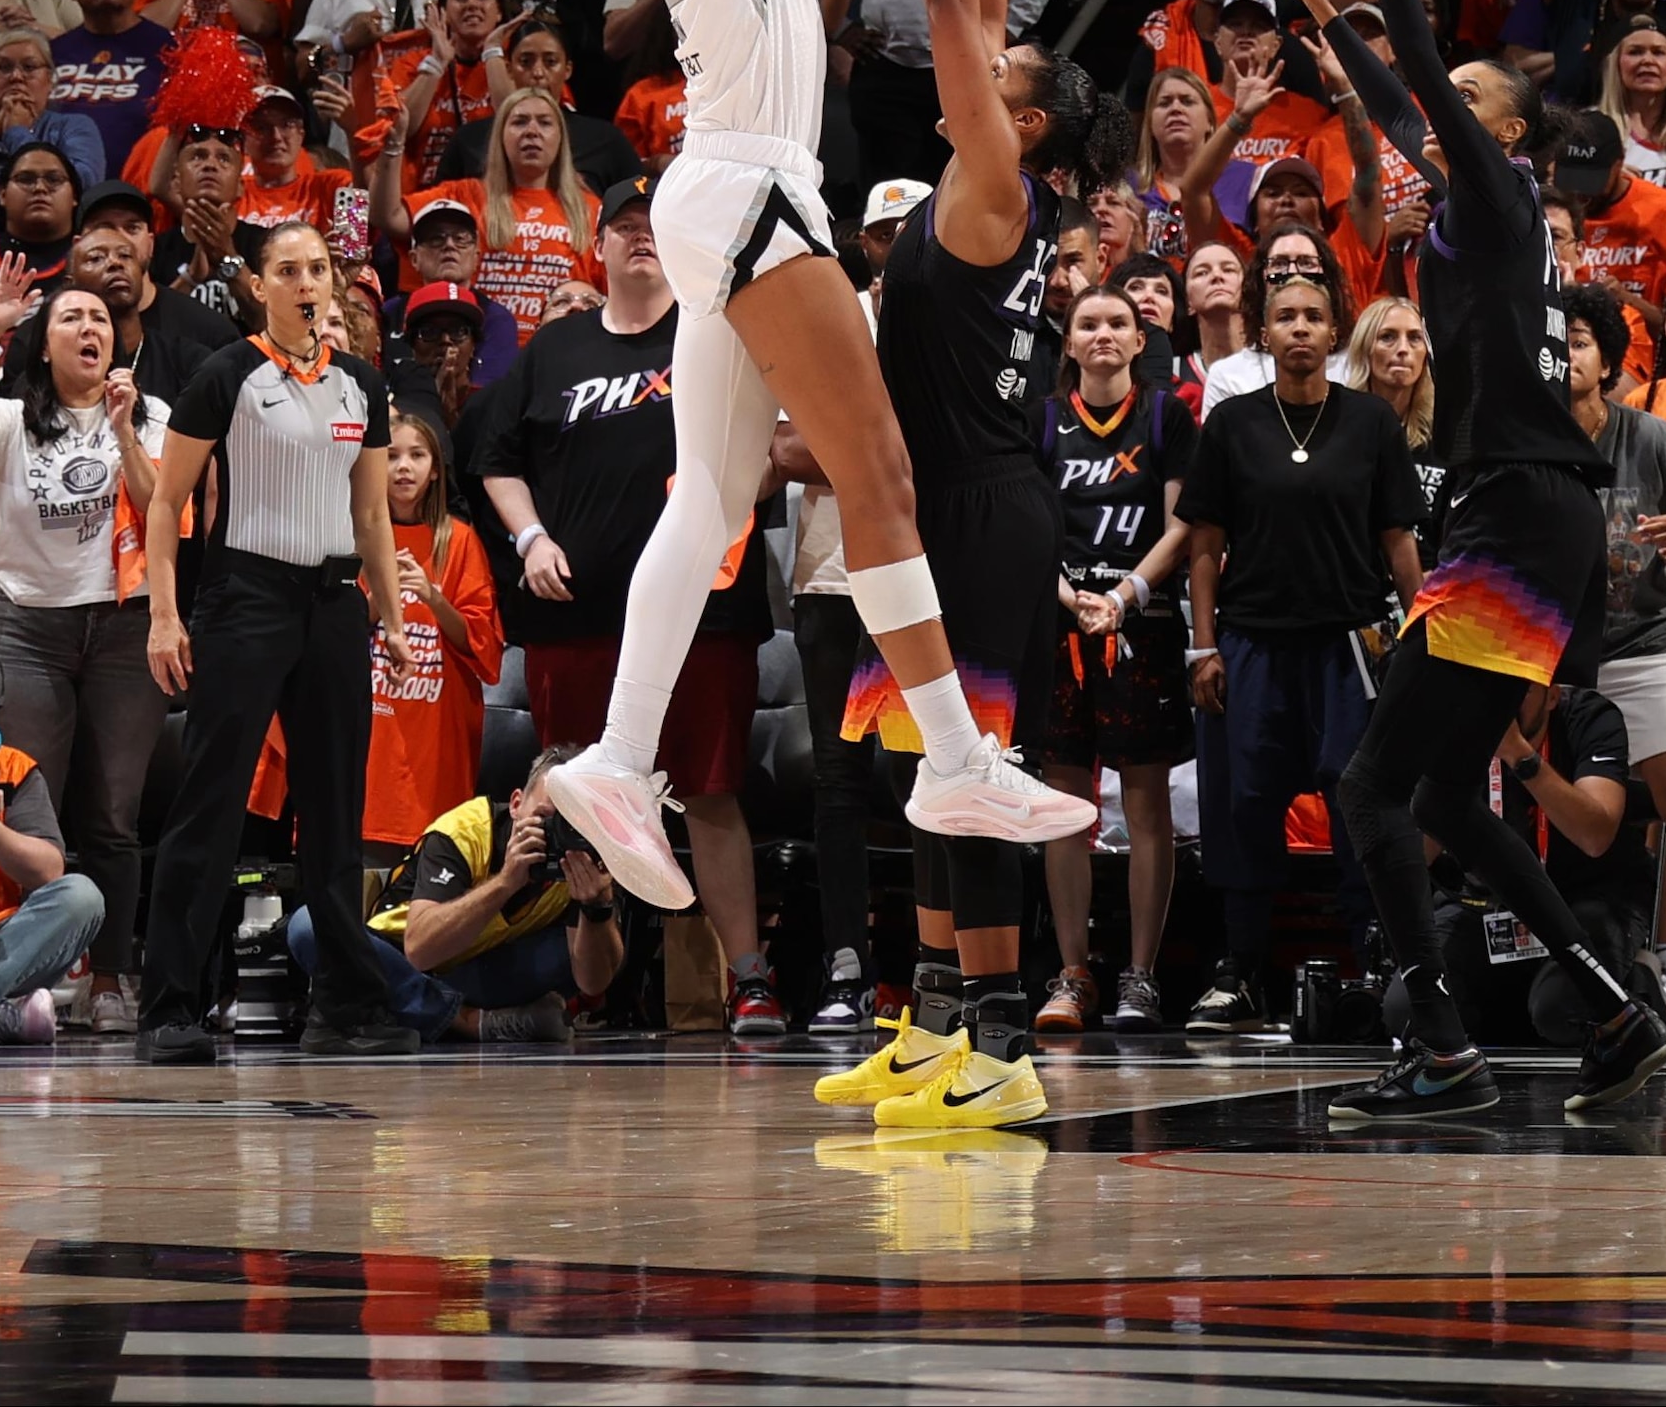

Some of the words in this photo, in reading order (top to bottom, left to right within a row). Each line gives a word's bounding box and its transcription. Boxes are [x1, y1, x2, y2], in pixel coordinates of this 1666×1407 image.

[54, 64, 148, 83] PLAY
[50, 83, 140, 102] OFFS
[522, 239, 540, 253] VS
[1581, 245, 1649, 268] RCURY
[568, 364, 675, 423] PHX
[1060, 444, 1144, 485] PHX
[38, 496, 120, 521] BASKETBA
[1092, 505, 1147, 547] 14
